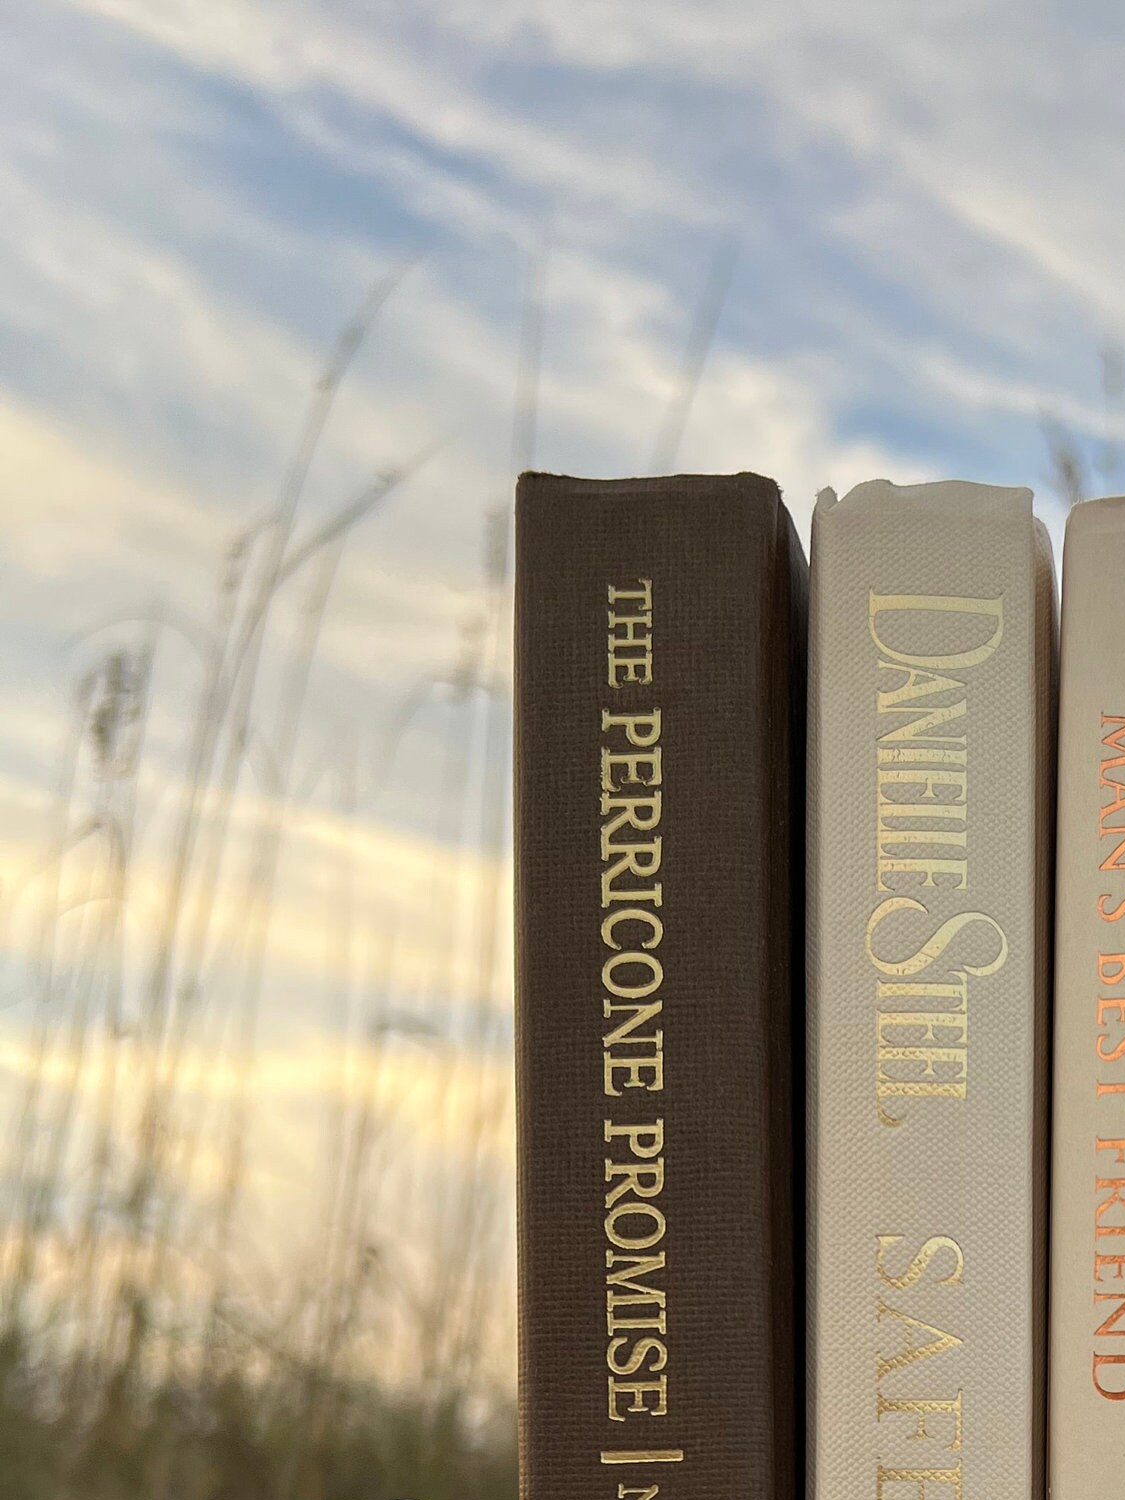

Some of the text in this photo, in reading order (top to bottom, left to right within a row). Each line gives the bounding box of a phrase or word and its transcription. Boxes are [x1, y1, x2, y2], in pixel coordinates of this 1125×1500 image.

[600, 578, 670, 1422] THE PERRICONE PROMISE
[864, 588, 1008, 1129] DANIELLE STEEL
